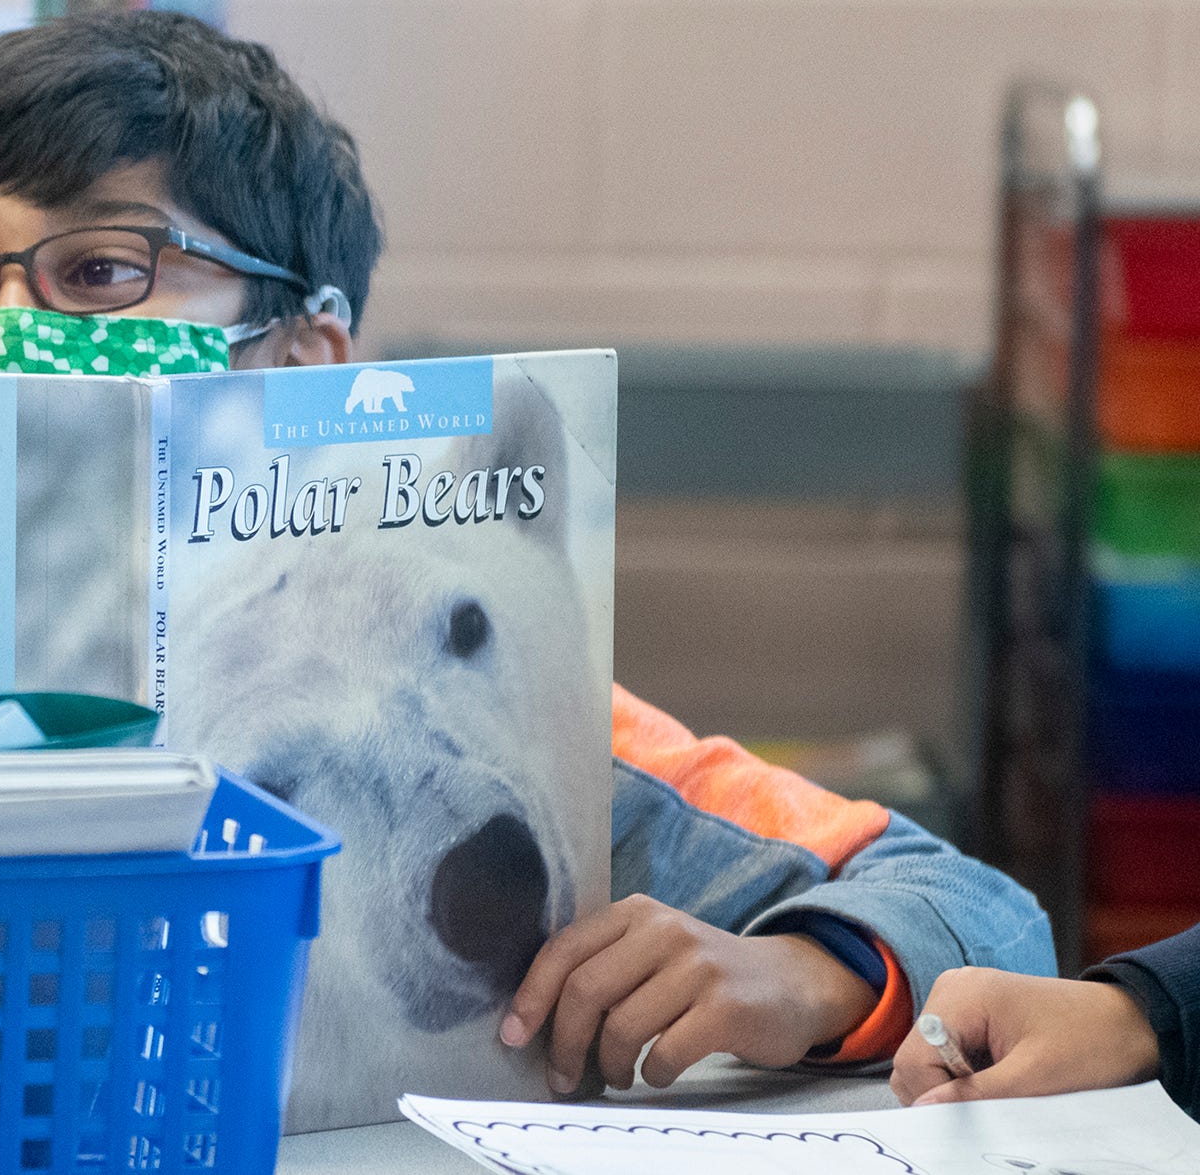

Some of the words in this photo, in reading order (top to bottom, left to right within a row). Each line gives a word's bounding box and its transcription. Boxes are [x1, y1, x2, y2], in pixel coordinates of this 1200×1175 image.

[272, 423, 309, 439] THE
[318, 418, 409, 437] UNTAMED
[418, 414, 486, 429] WORLD
[157, 470, 168, 534] UNTAMED
[187, 454, 362, 543] Polar
[377, 453, 546, 530] Bears
[156, 538, 167, 590] WORLD
[155, 611, 166, 663] POLAR
